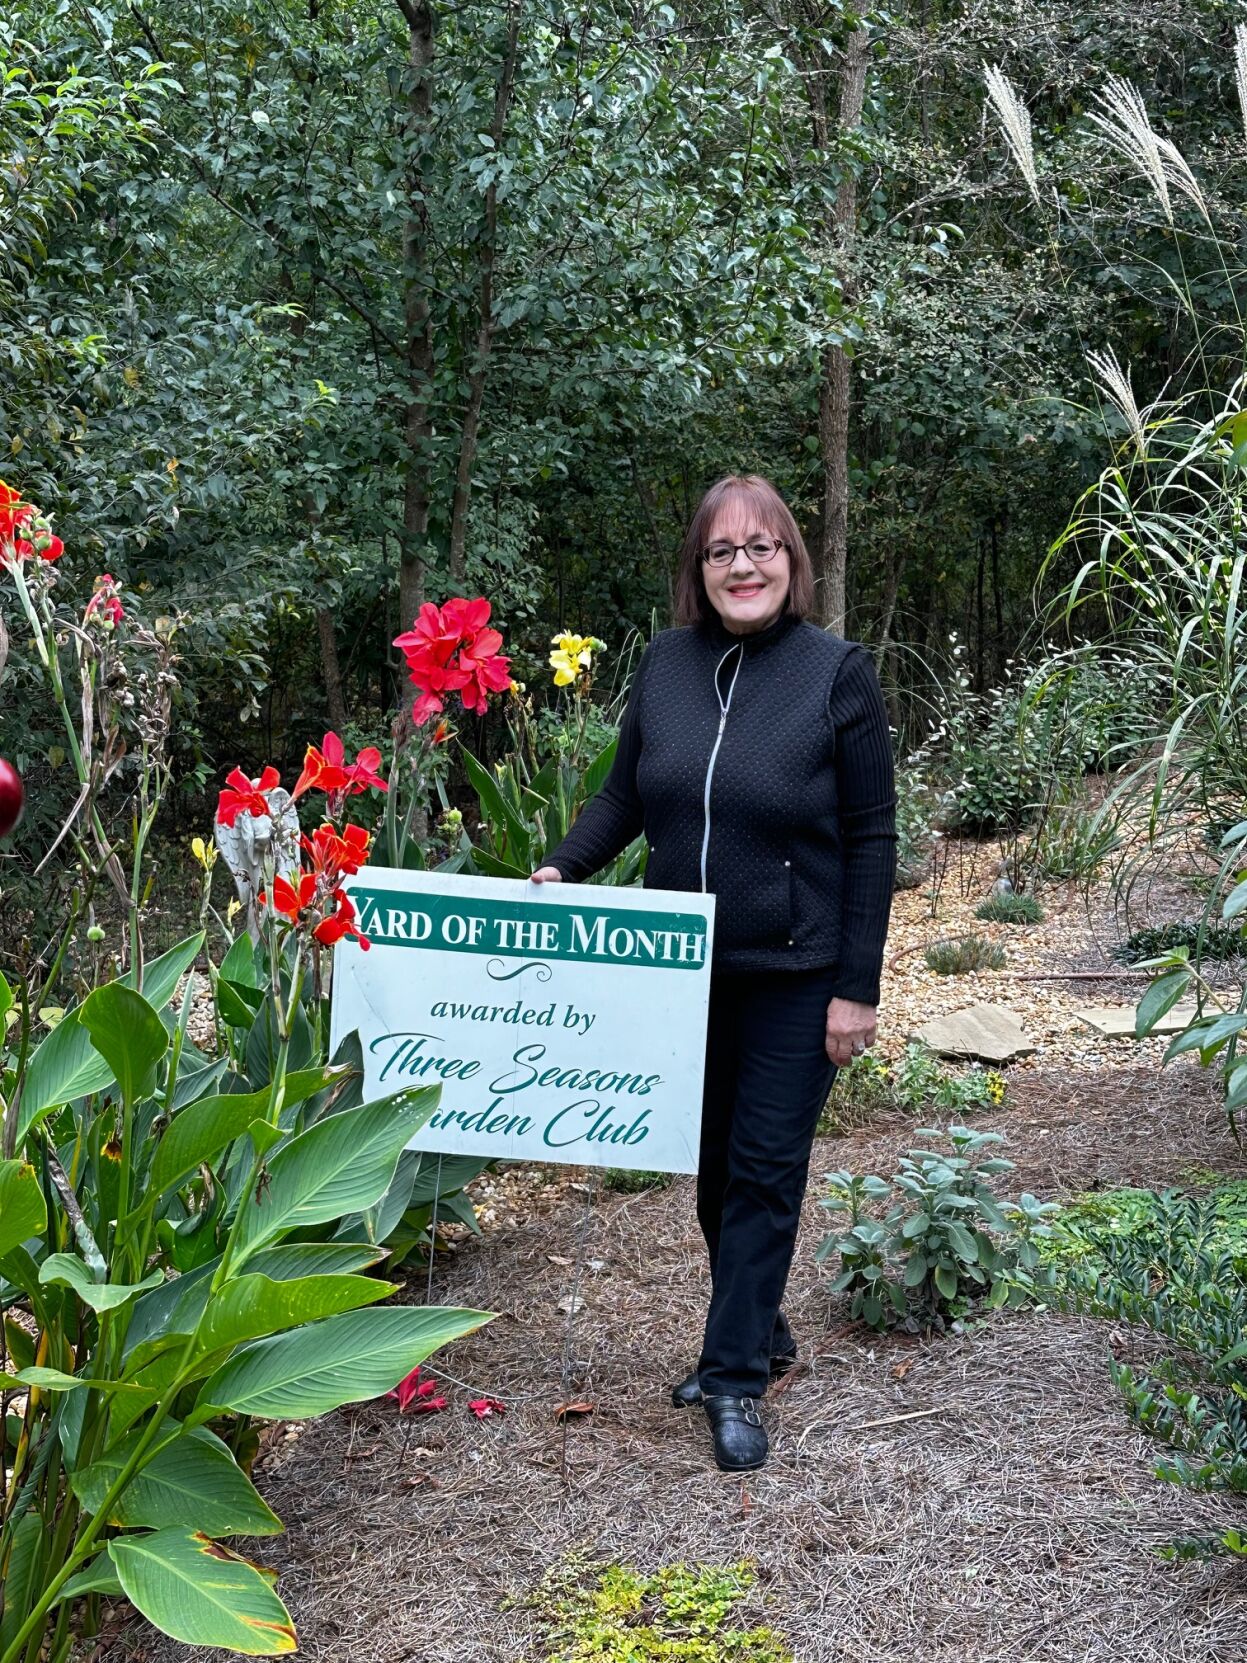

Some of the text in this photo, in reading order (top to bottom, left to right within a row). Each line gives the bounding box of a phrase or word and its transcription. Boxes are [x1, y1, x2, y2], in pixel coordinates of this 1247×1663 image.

[347, 895, 705, 963] YARD OF THE MONTH
[430, 1000, 597, 1036] awarded by
[369, 1032, 666, 1096] Three Seasons
[425, 1096, 653, 1148] rden Club
